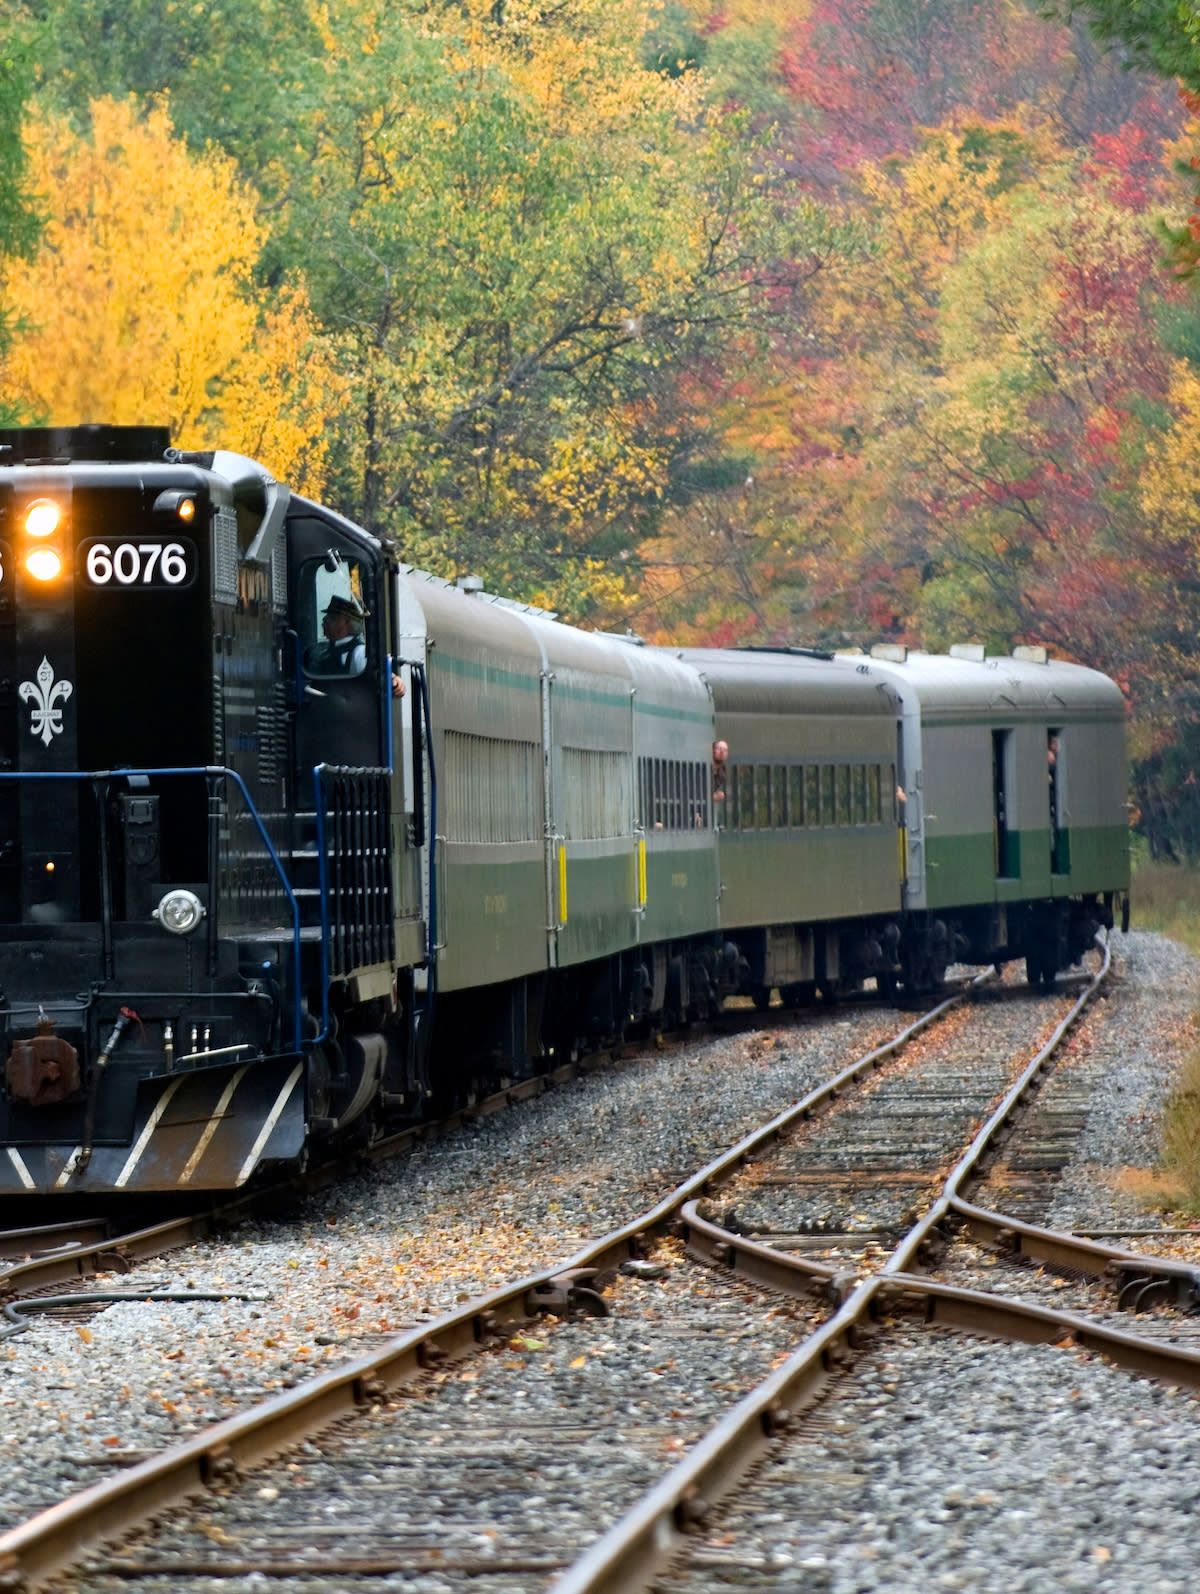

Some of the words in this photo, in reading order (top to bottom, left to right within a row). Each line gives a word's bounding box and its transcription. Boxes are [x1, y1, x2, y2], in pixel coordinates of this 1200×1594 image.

[86, 543, 187, 584] 6076
[24, 684, 33, 693] A
[60, 683, 69, 692] L
